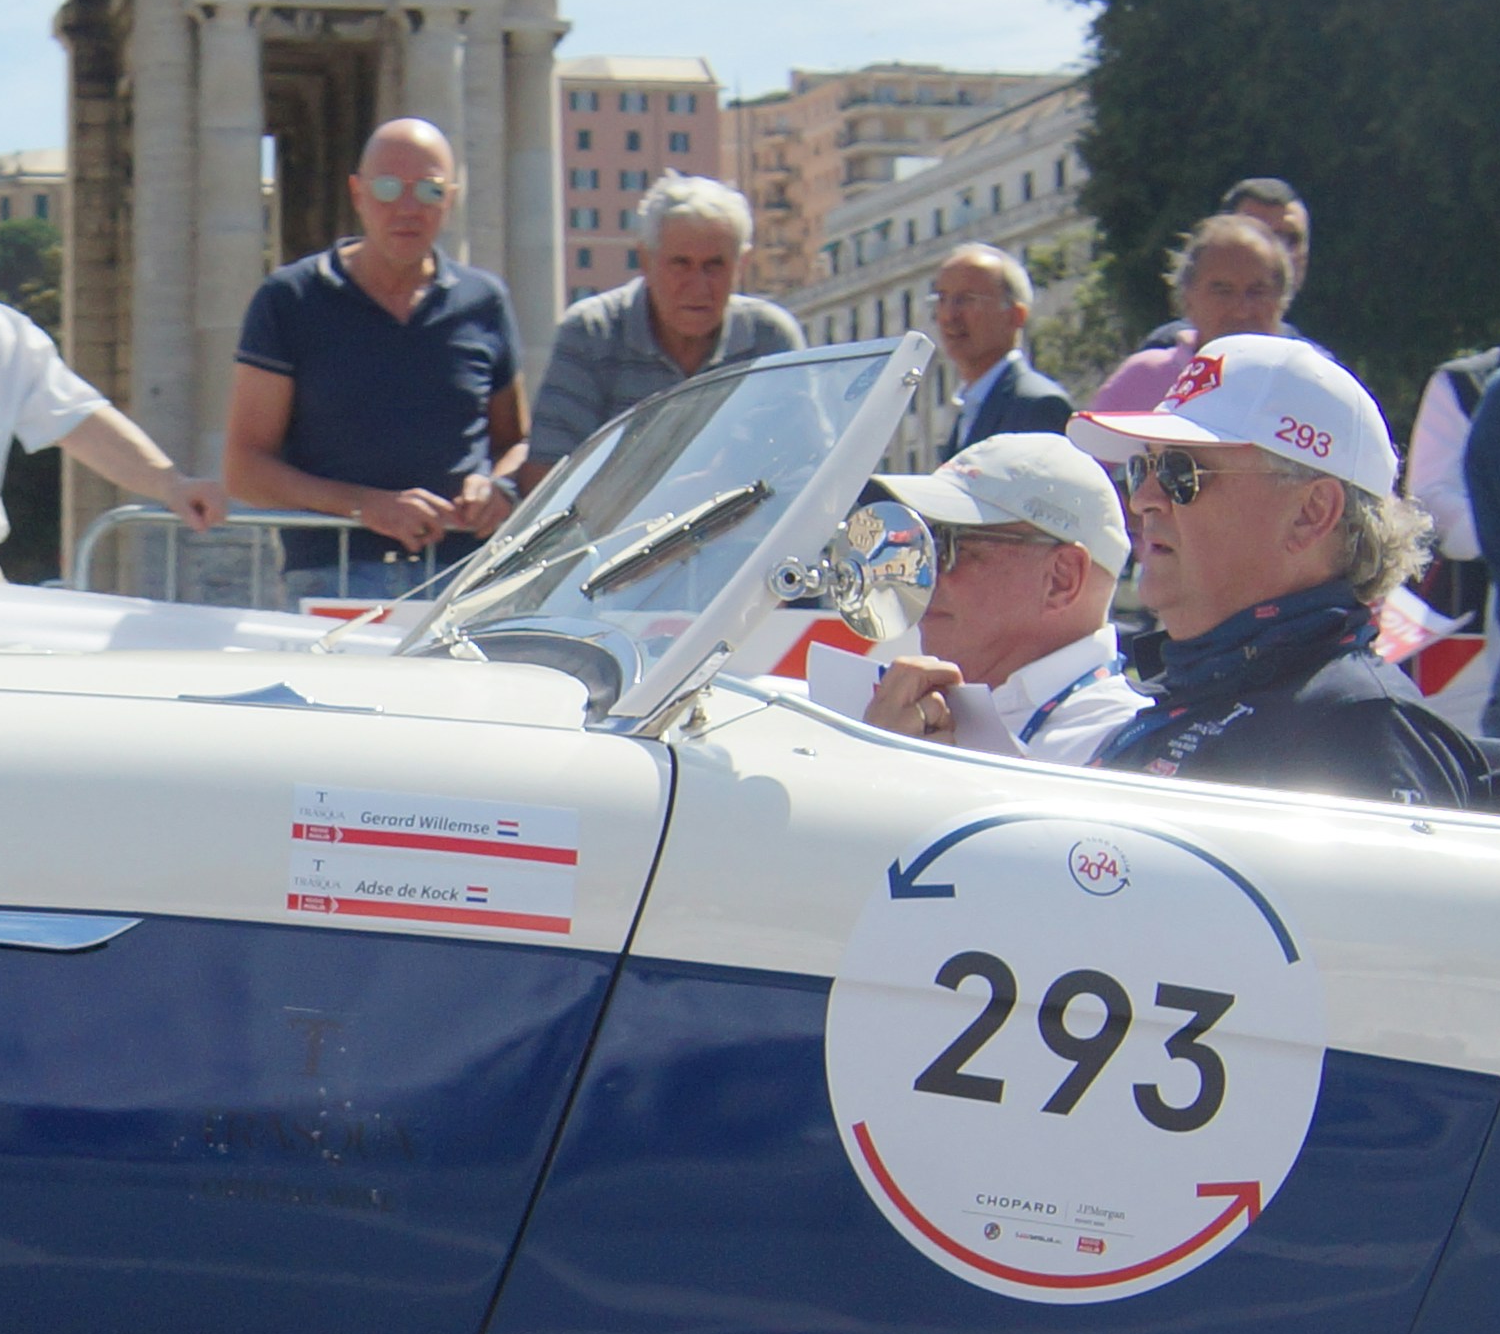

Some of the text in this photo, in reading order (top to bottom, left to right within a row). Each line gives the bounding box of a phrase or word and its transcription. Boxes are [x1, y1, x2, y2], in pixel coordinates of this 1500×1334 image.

[1274, 416, 1333, 458] 293
[360, 810, 491, 836] Gerard Willemse
[1077, 851, 1119, 881] 2024
[354, 879, 460, 902] Adse de Kock
[913, 950, 1237, 1133] 293
[976, 1193, 1058, 1216] CHOPARD
